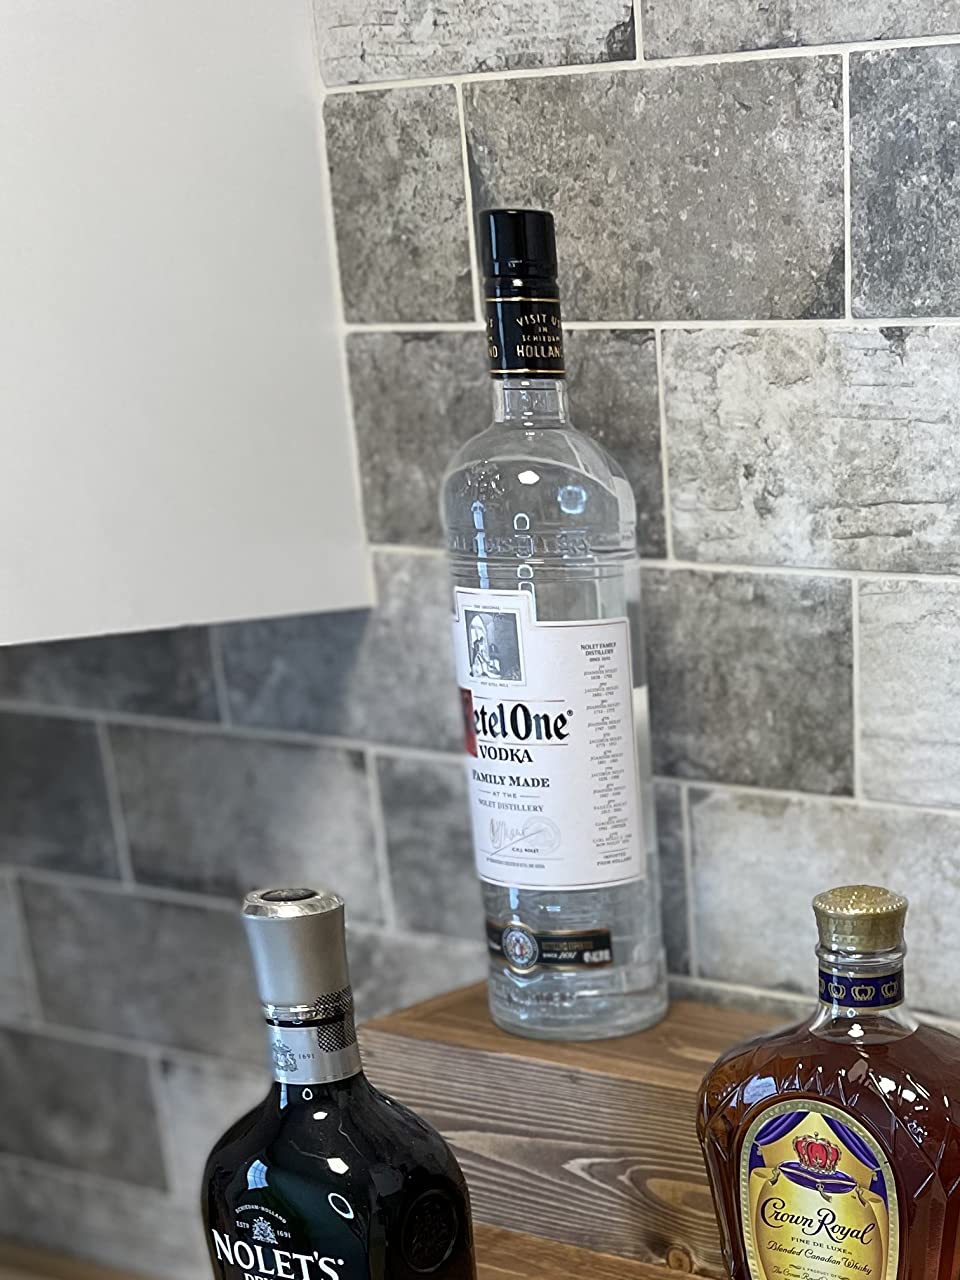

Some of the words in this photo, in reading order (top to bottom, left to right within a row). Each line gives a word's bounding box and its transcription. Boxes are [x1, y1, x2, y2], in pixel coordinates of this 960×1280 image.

[516, 314, 547, 327] VISIT
[516, 344, 564, 358] HOLLAN
[479, 745, 534, 763] VODKA
[473, 769, 506, 785] FAMILY
[509, 776, 550, 788] MADE
[498, 801, 544, 812] DISTILLERY
[760, 1197, 814, 1229] Crown
[802, 1208, 876, 1245] Royal
[276, 1229, 291, 1238] 1691
[791, 1236, 811, 1246] FINE
[766, 1240, 804, 1256] Blended
[804, 1249, 841, 1266] Canadian
[841, 1257, 872, 1275] Whisky
[782, 1266, 801, 1279] Crown
